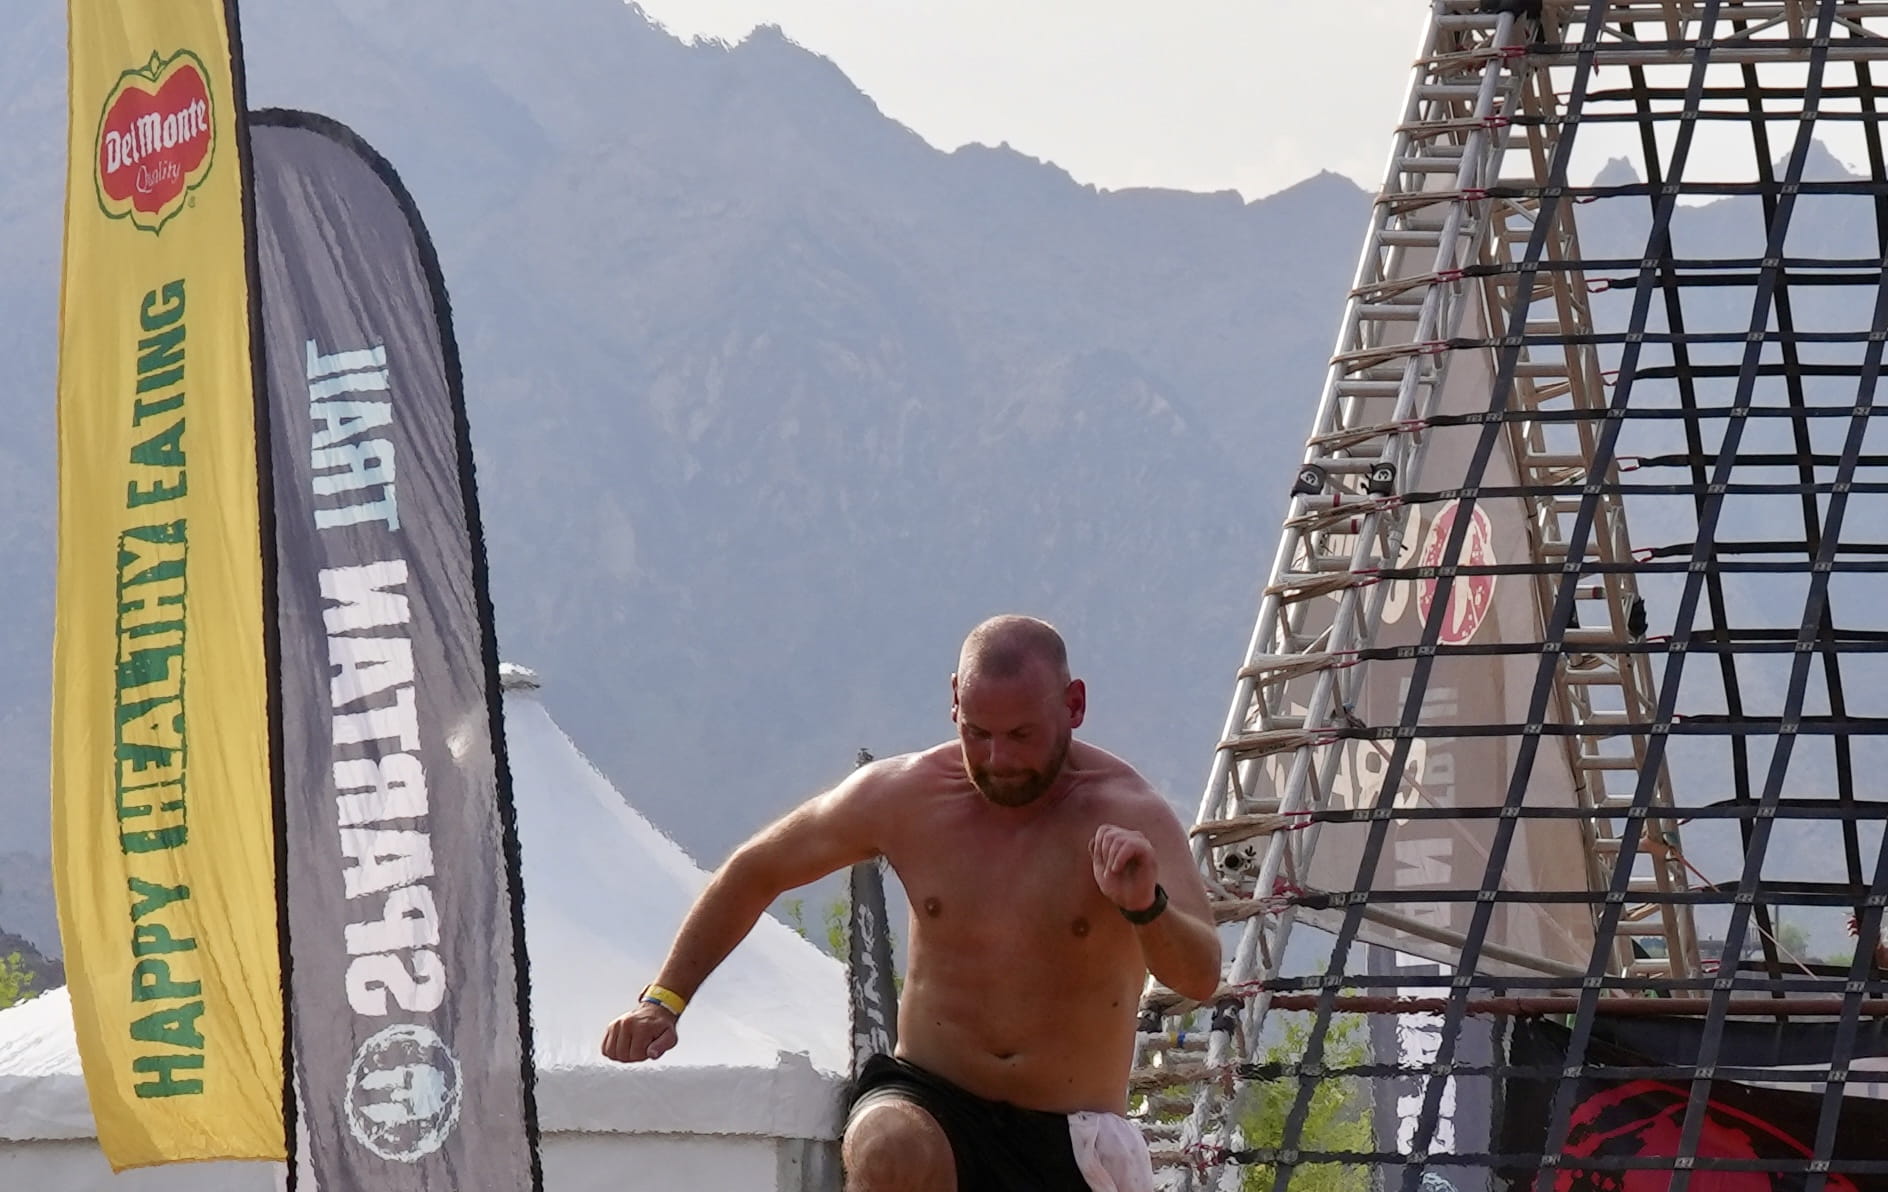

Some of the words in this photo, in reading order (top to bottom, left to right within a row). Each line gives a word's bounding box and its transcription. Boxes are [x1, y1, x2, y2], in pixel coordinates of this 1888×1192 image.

[136, 160, 181, 193] Quality
[126, 278, 188, 509] EATING
[114, 519, 188, 855] HEALTHY
[128, 876, 205, 1099] HAPPY
